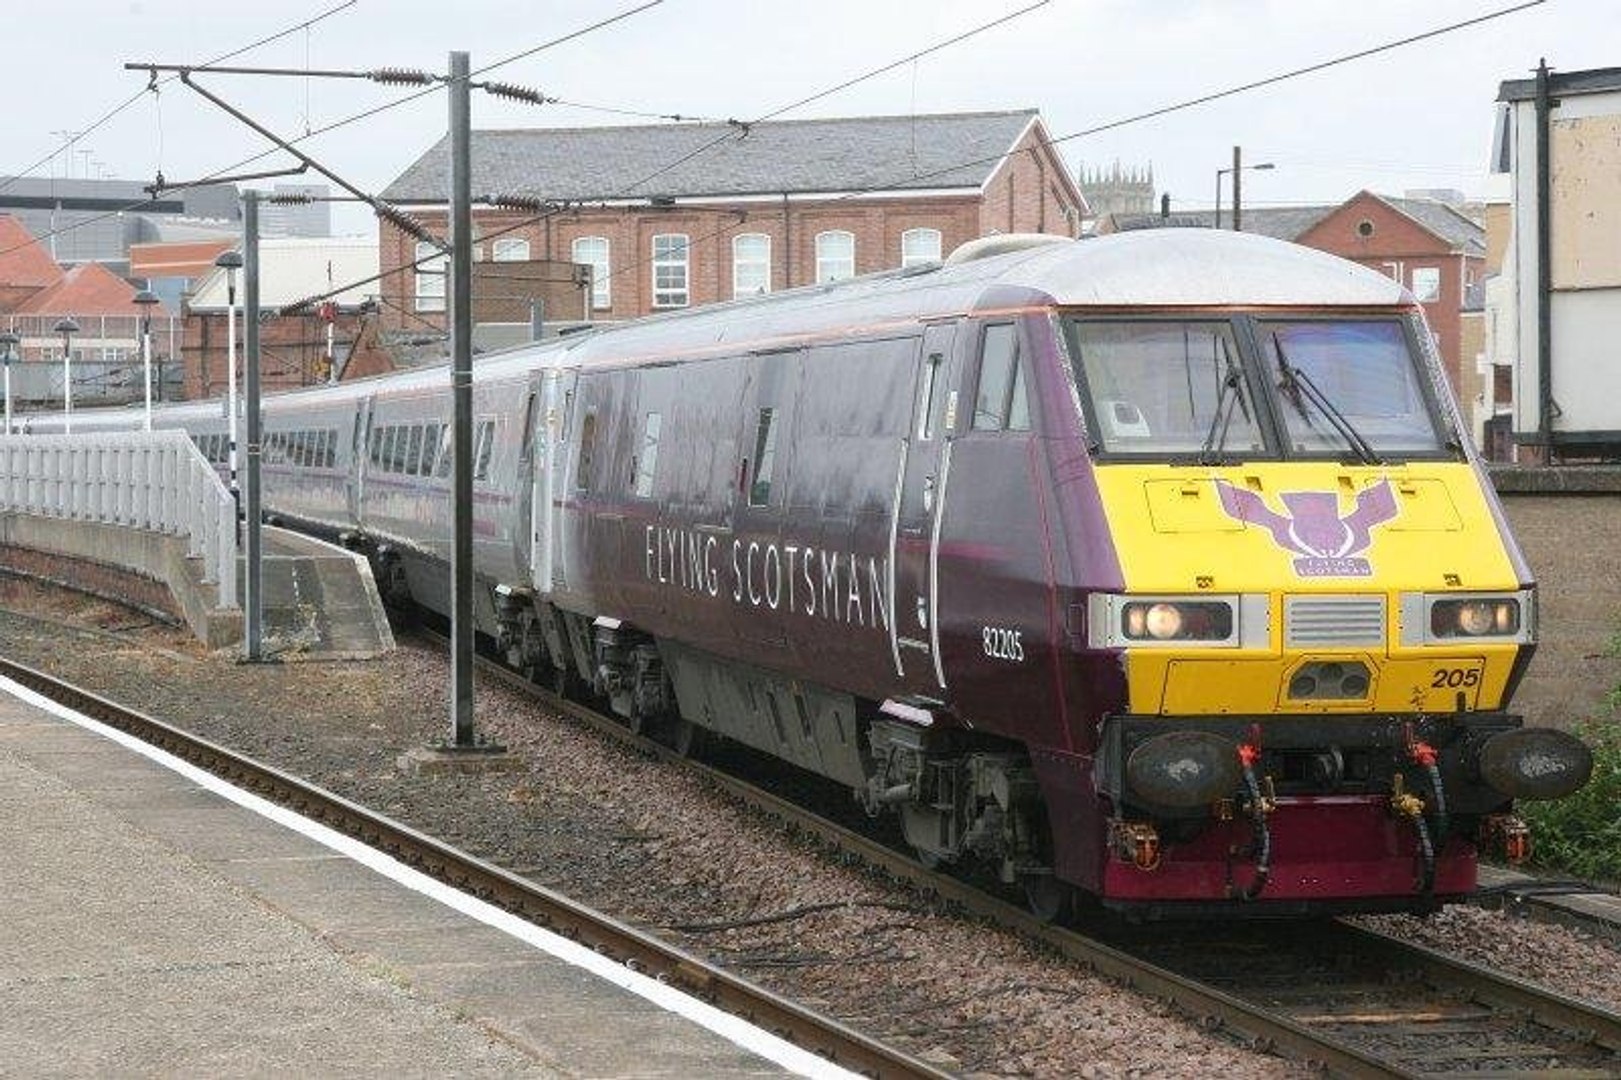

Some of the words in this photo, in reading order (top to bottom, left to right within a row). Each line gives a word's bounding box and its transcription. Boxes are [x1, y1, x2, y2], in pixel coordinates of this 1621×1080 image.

[646, 525, 718, 597] FLYING
[733, 539, 888, 631] SCOTSMAN
[983, 626, 1024, 661] 82205
[1431, 668, 1480, 688] 205
